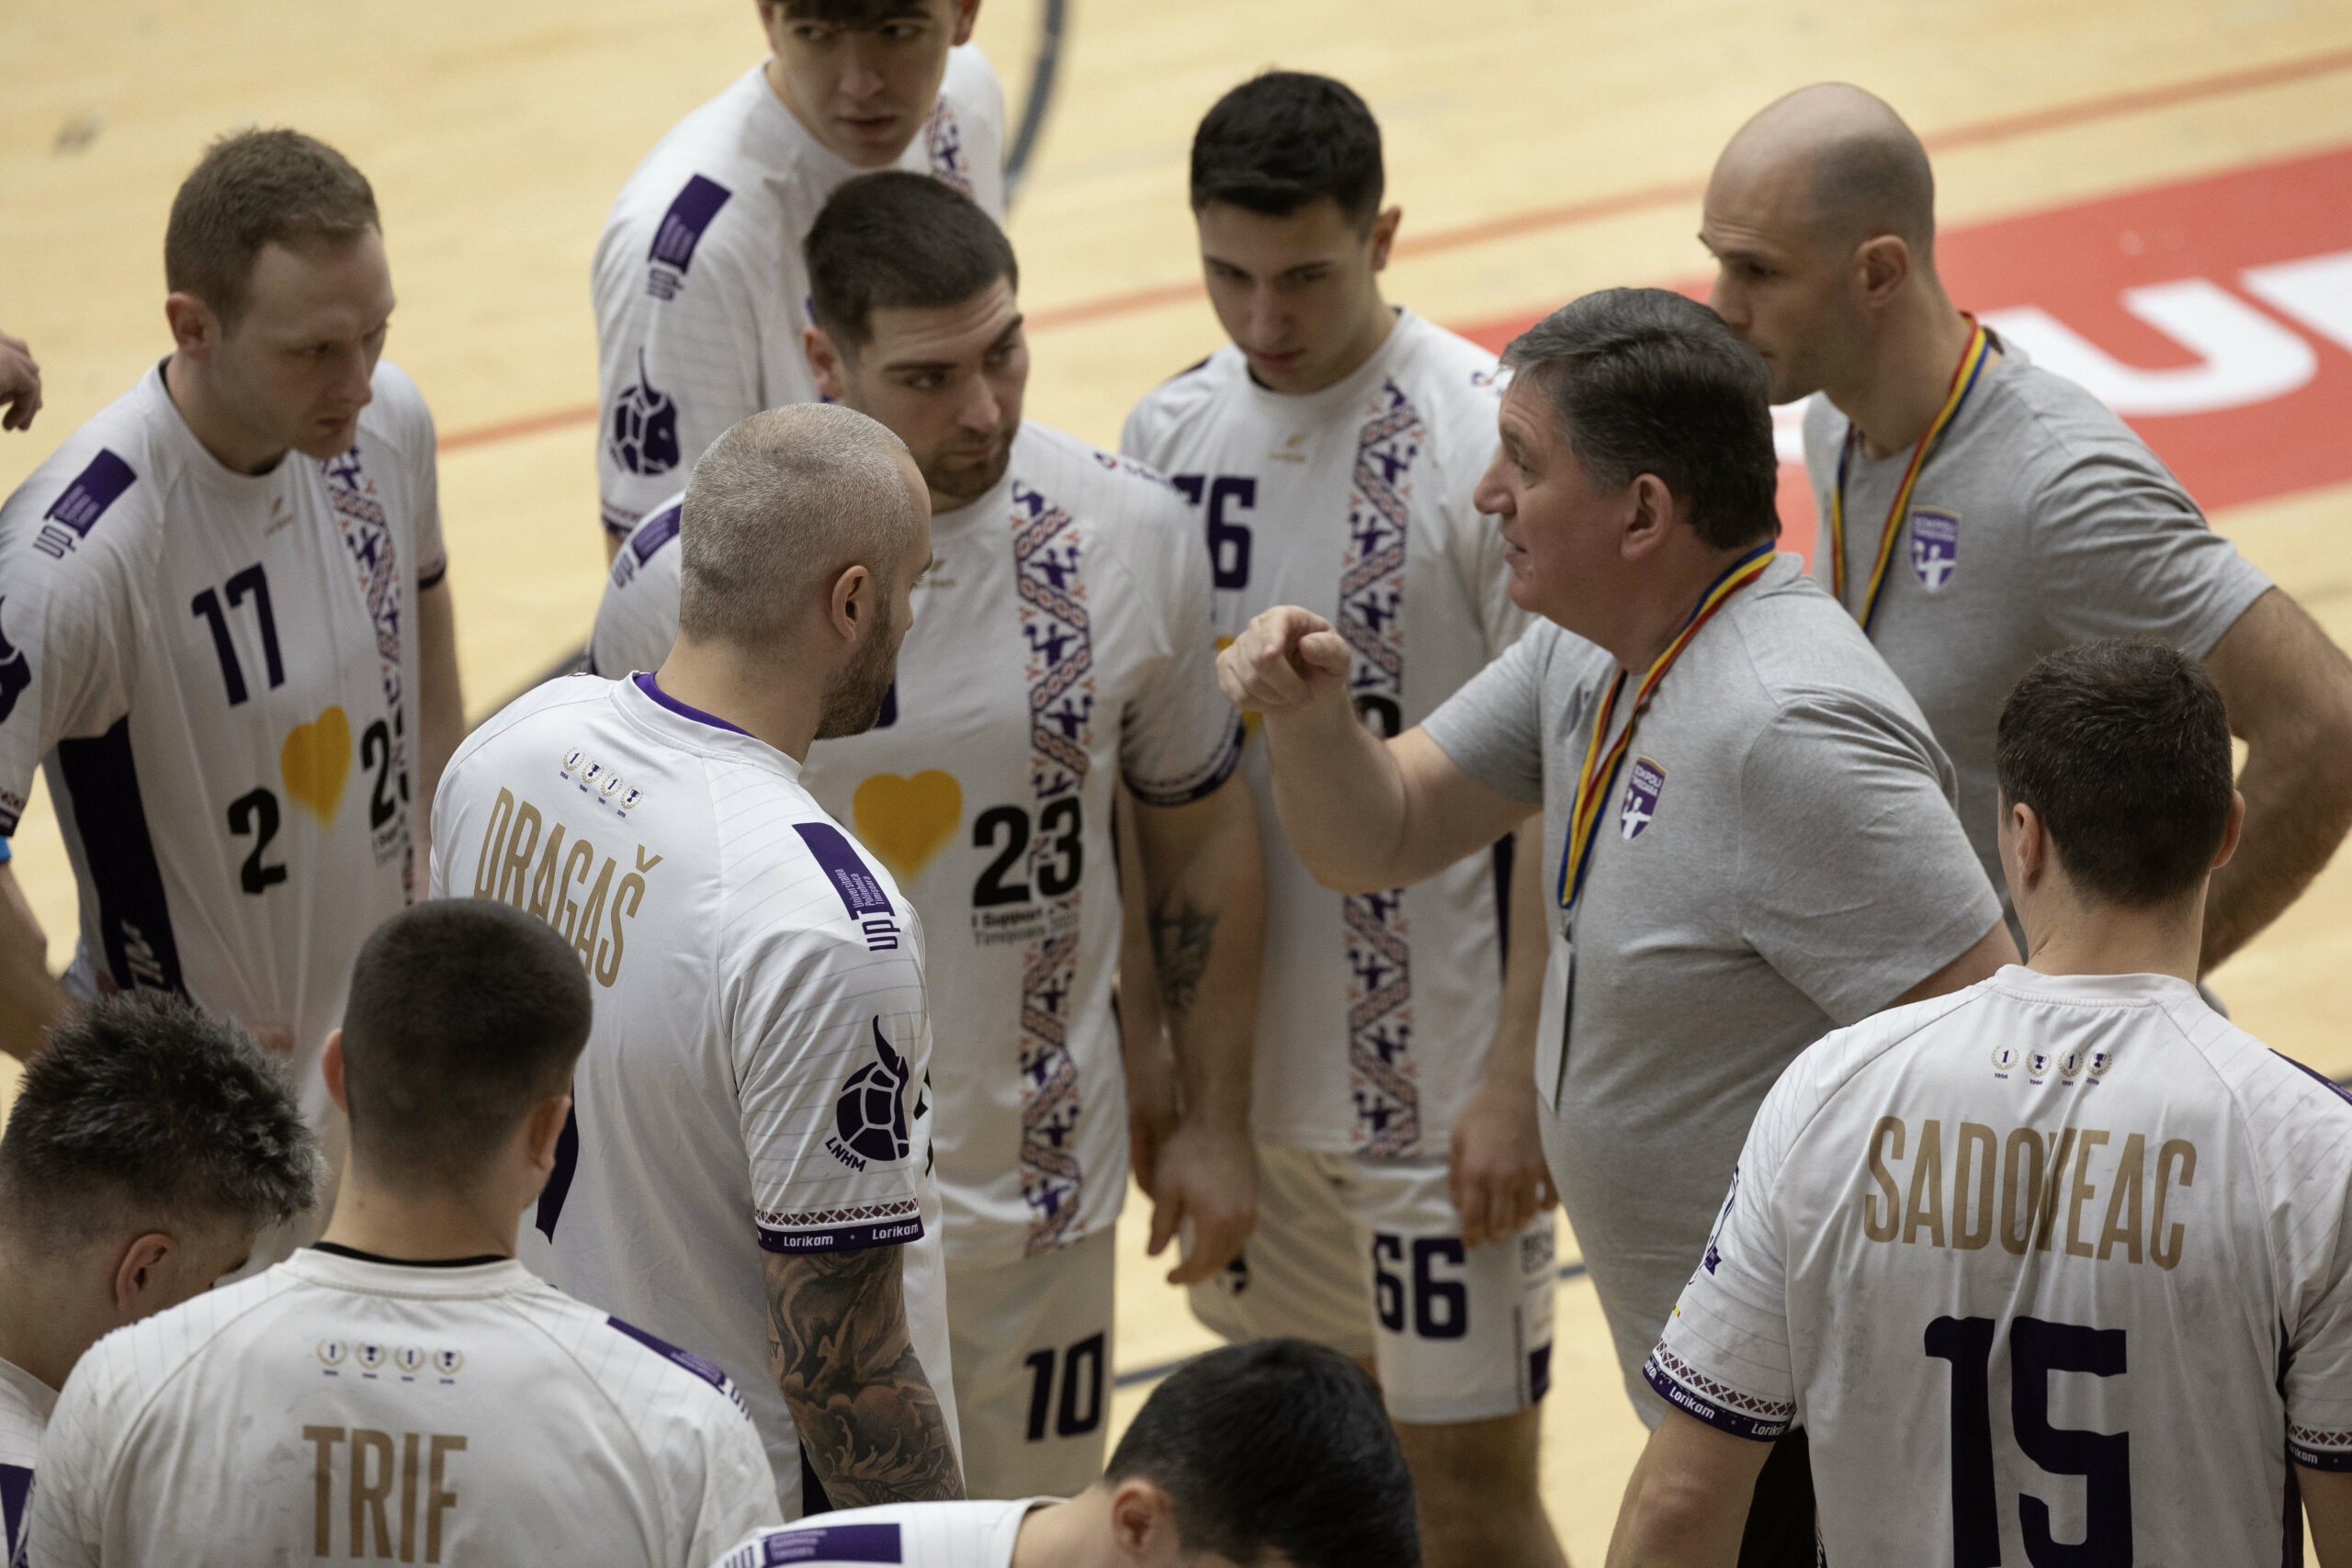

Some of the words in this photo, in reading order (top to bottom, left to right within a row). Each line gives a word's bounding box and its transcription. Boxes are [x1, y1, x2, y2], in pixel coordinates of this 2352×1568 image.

[1171, 475, 1257, 590] 6
[191, 561, 286, 707] 17
[228, 787, 287, 894] 2
[473, 786, 663, 987] DRAGAŠ
[973, 795, 1082, 908] 23
[825, 1136, 866, 1172] LNHM
[1864, 1115, 2197, 1270] SADOVEAC
[784, 1235, 833, 1247] Lorikam
[873, 1224, 919, 1240] Lorikam
[1374, 1234, 1466, 1338] 66
[1026, 1333, 1105, 1440] 10
[1669, 1386, 1715, 1419] Lorikam
[1751, 1423, 1786, 1437] Lorik
[1924, 1315, 2133, 1568] 15
[303, 1426, 468, 1563] TRIF
